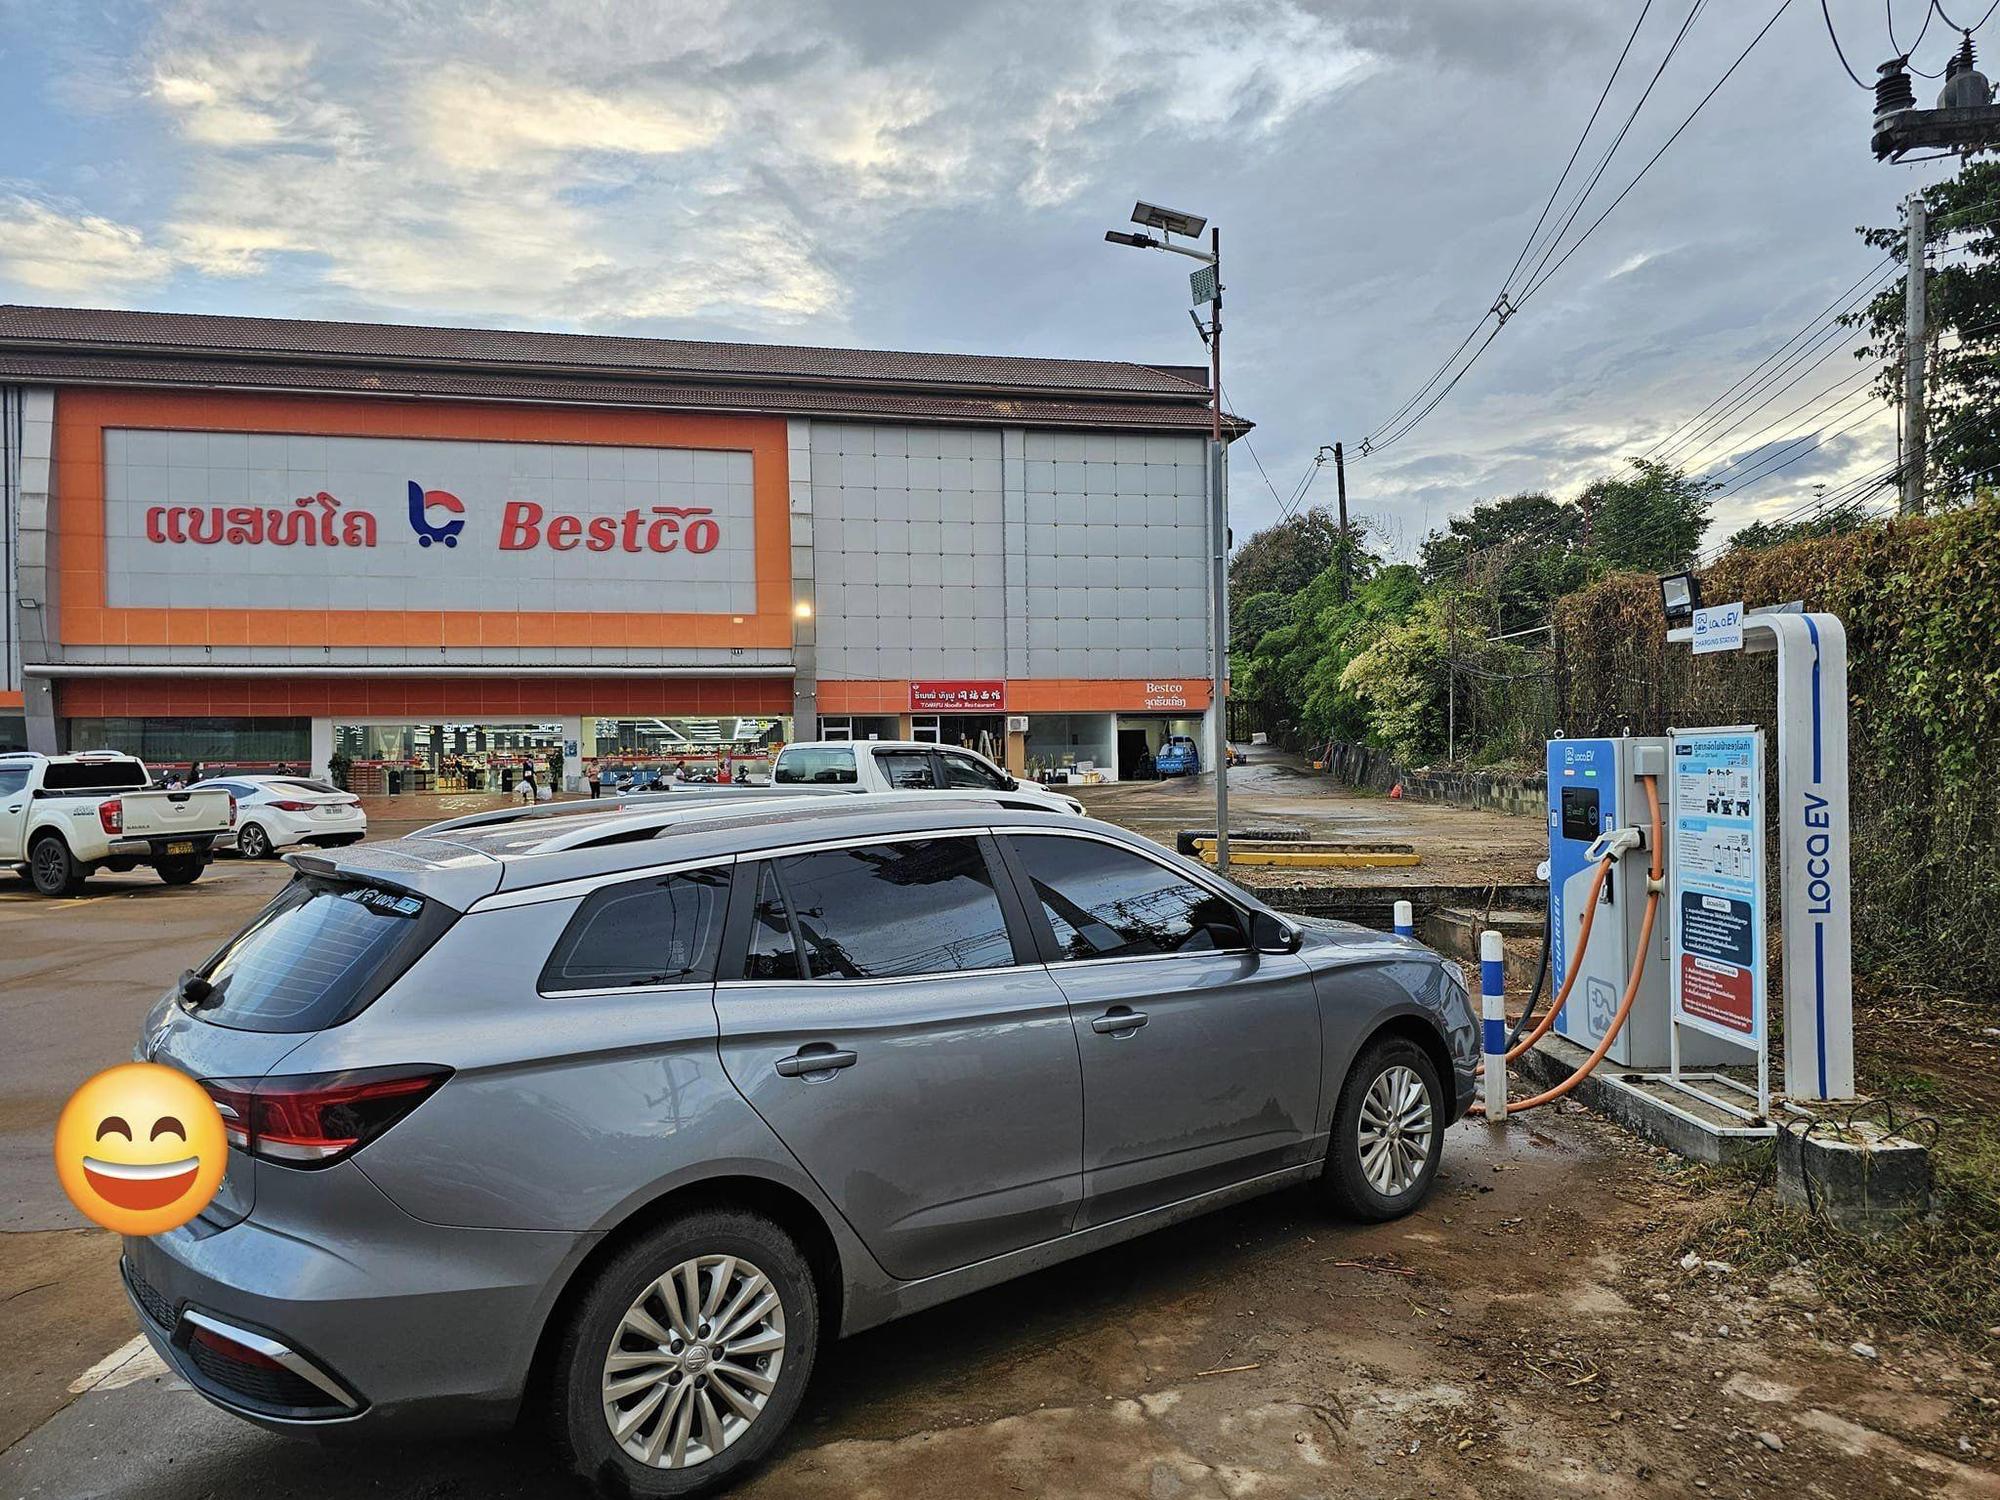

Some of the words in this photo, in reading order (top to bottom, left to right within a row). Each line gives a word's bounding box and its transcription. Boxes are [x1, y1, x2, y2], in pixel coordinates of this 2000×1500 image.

[498, 501, 720, 554] Bestco
[1146, 682, 1183, 693] Bestco
[1553, 895, 1562, 972] CHARGER
